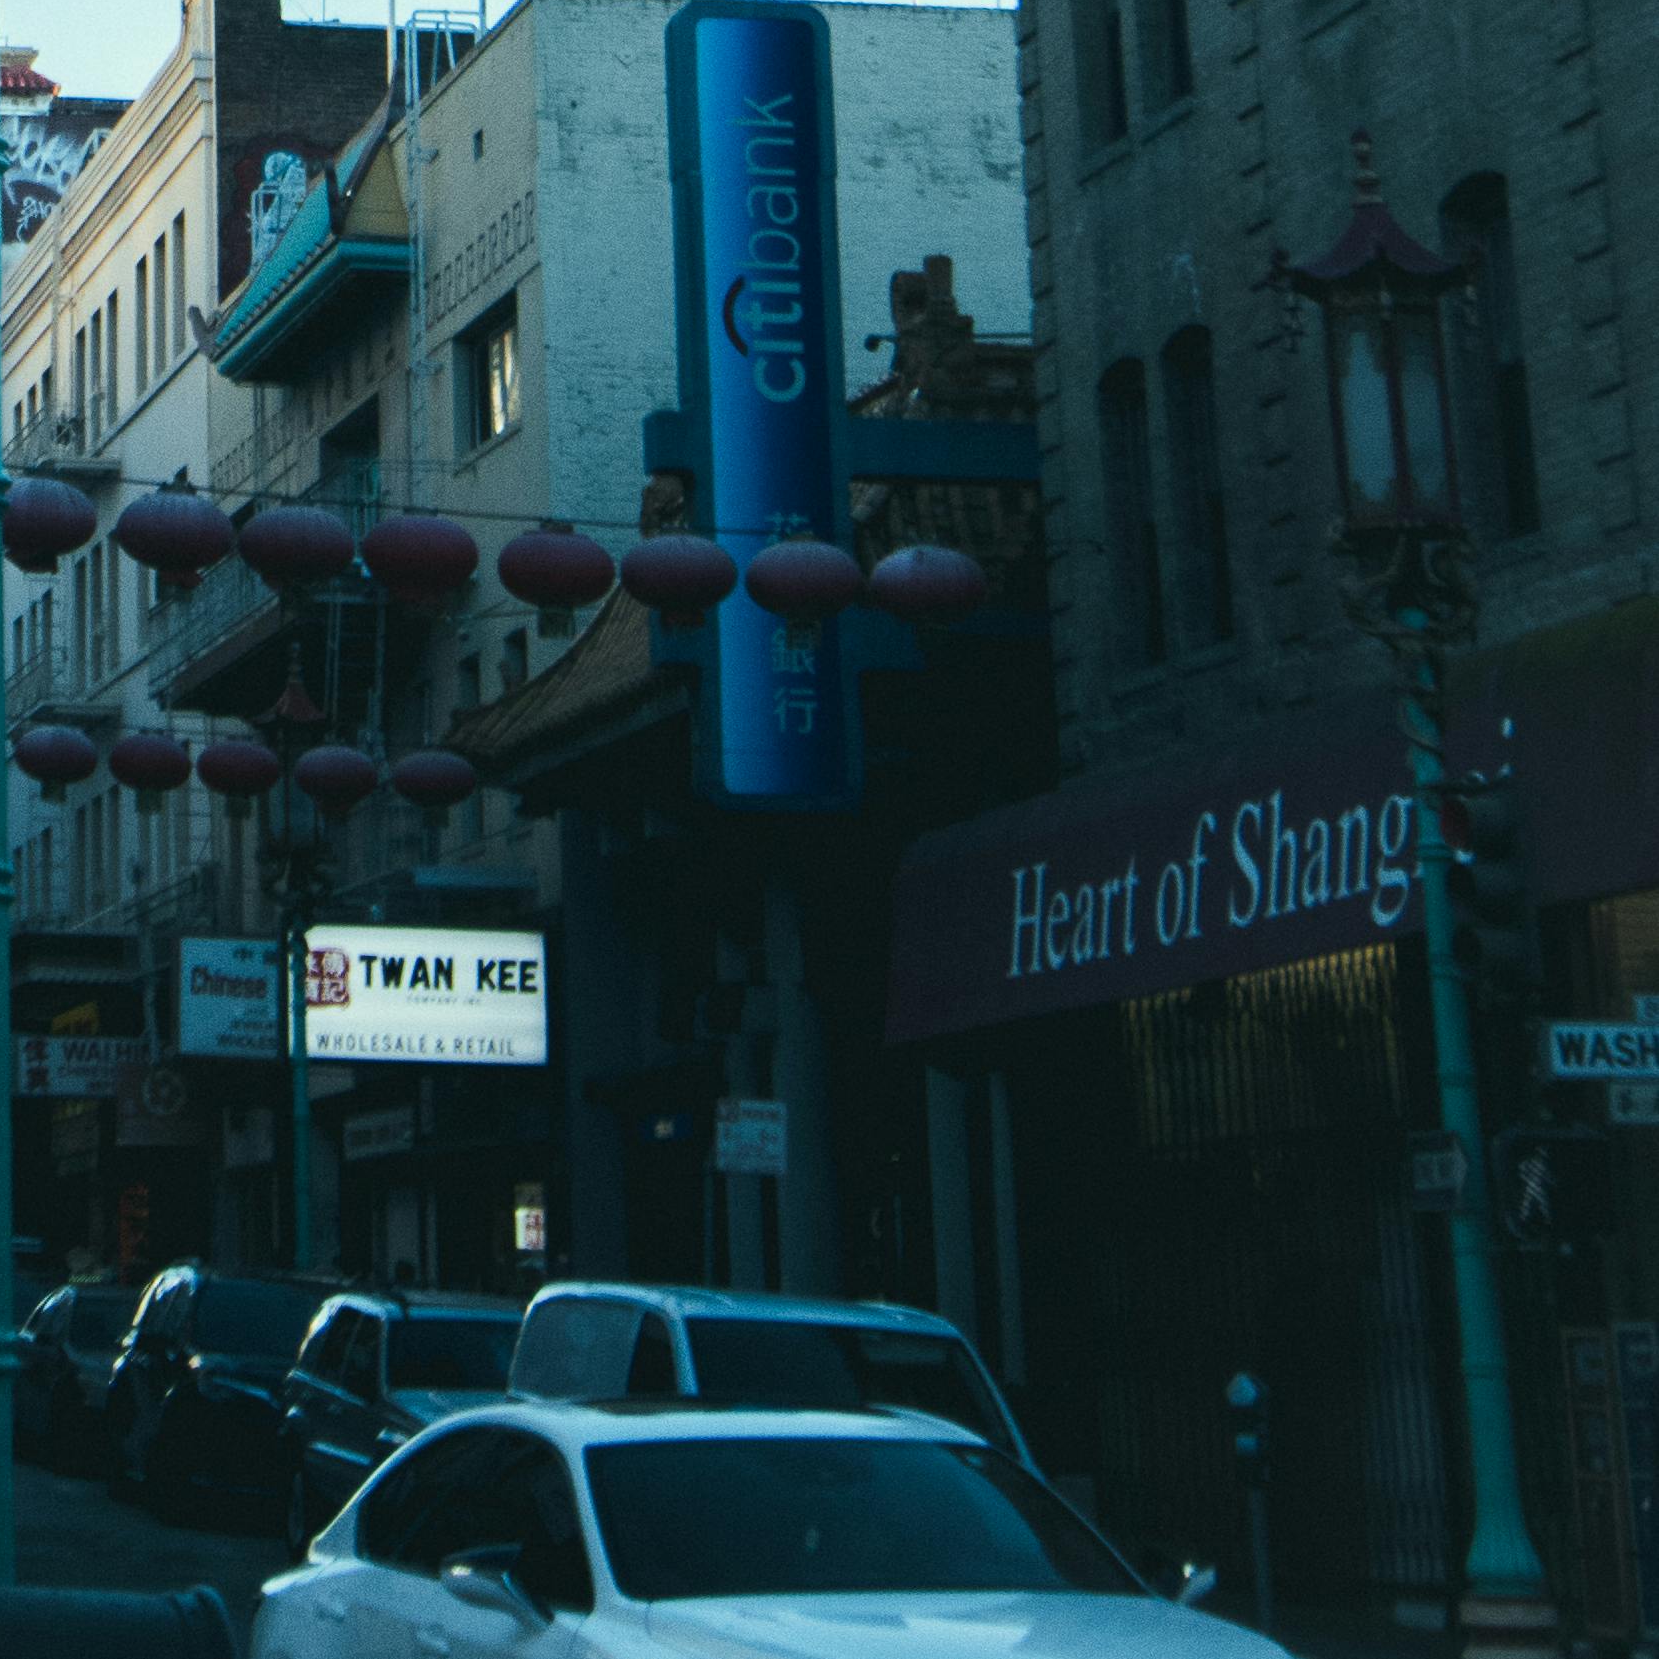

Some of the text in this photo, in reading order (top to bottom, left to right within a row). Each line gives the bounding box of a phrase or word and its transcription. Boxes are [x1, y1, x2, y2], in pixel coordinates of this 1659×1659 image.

[734, 93, 806, 402] citibank
[1006, 787, 1422, 979] Heart of Shang
[359, 955, 454, 990] TWAN
[477, 958, 538, 994] KEE
[316, 1034, 516, 1057] WHOLESALE & RETAIL
[1556, 1032, 1659, 1068] WASH
